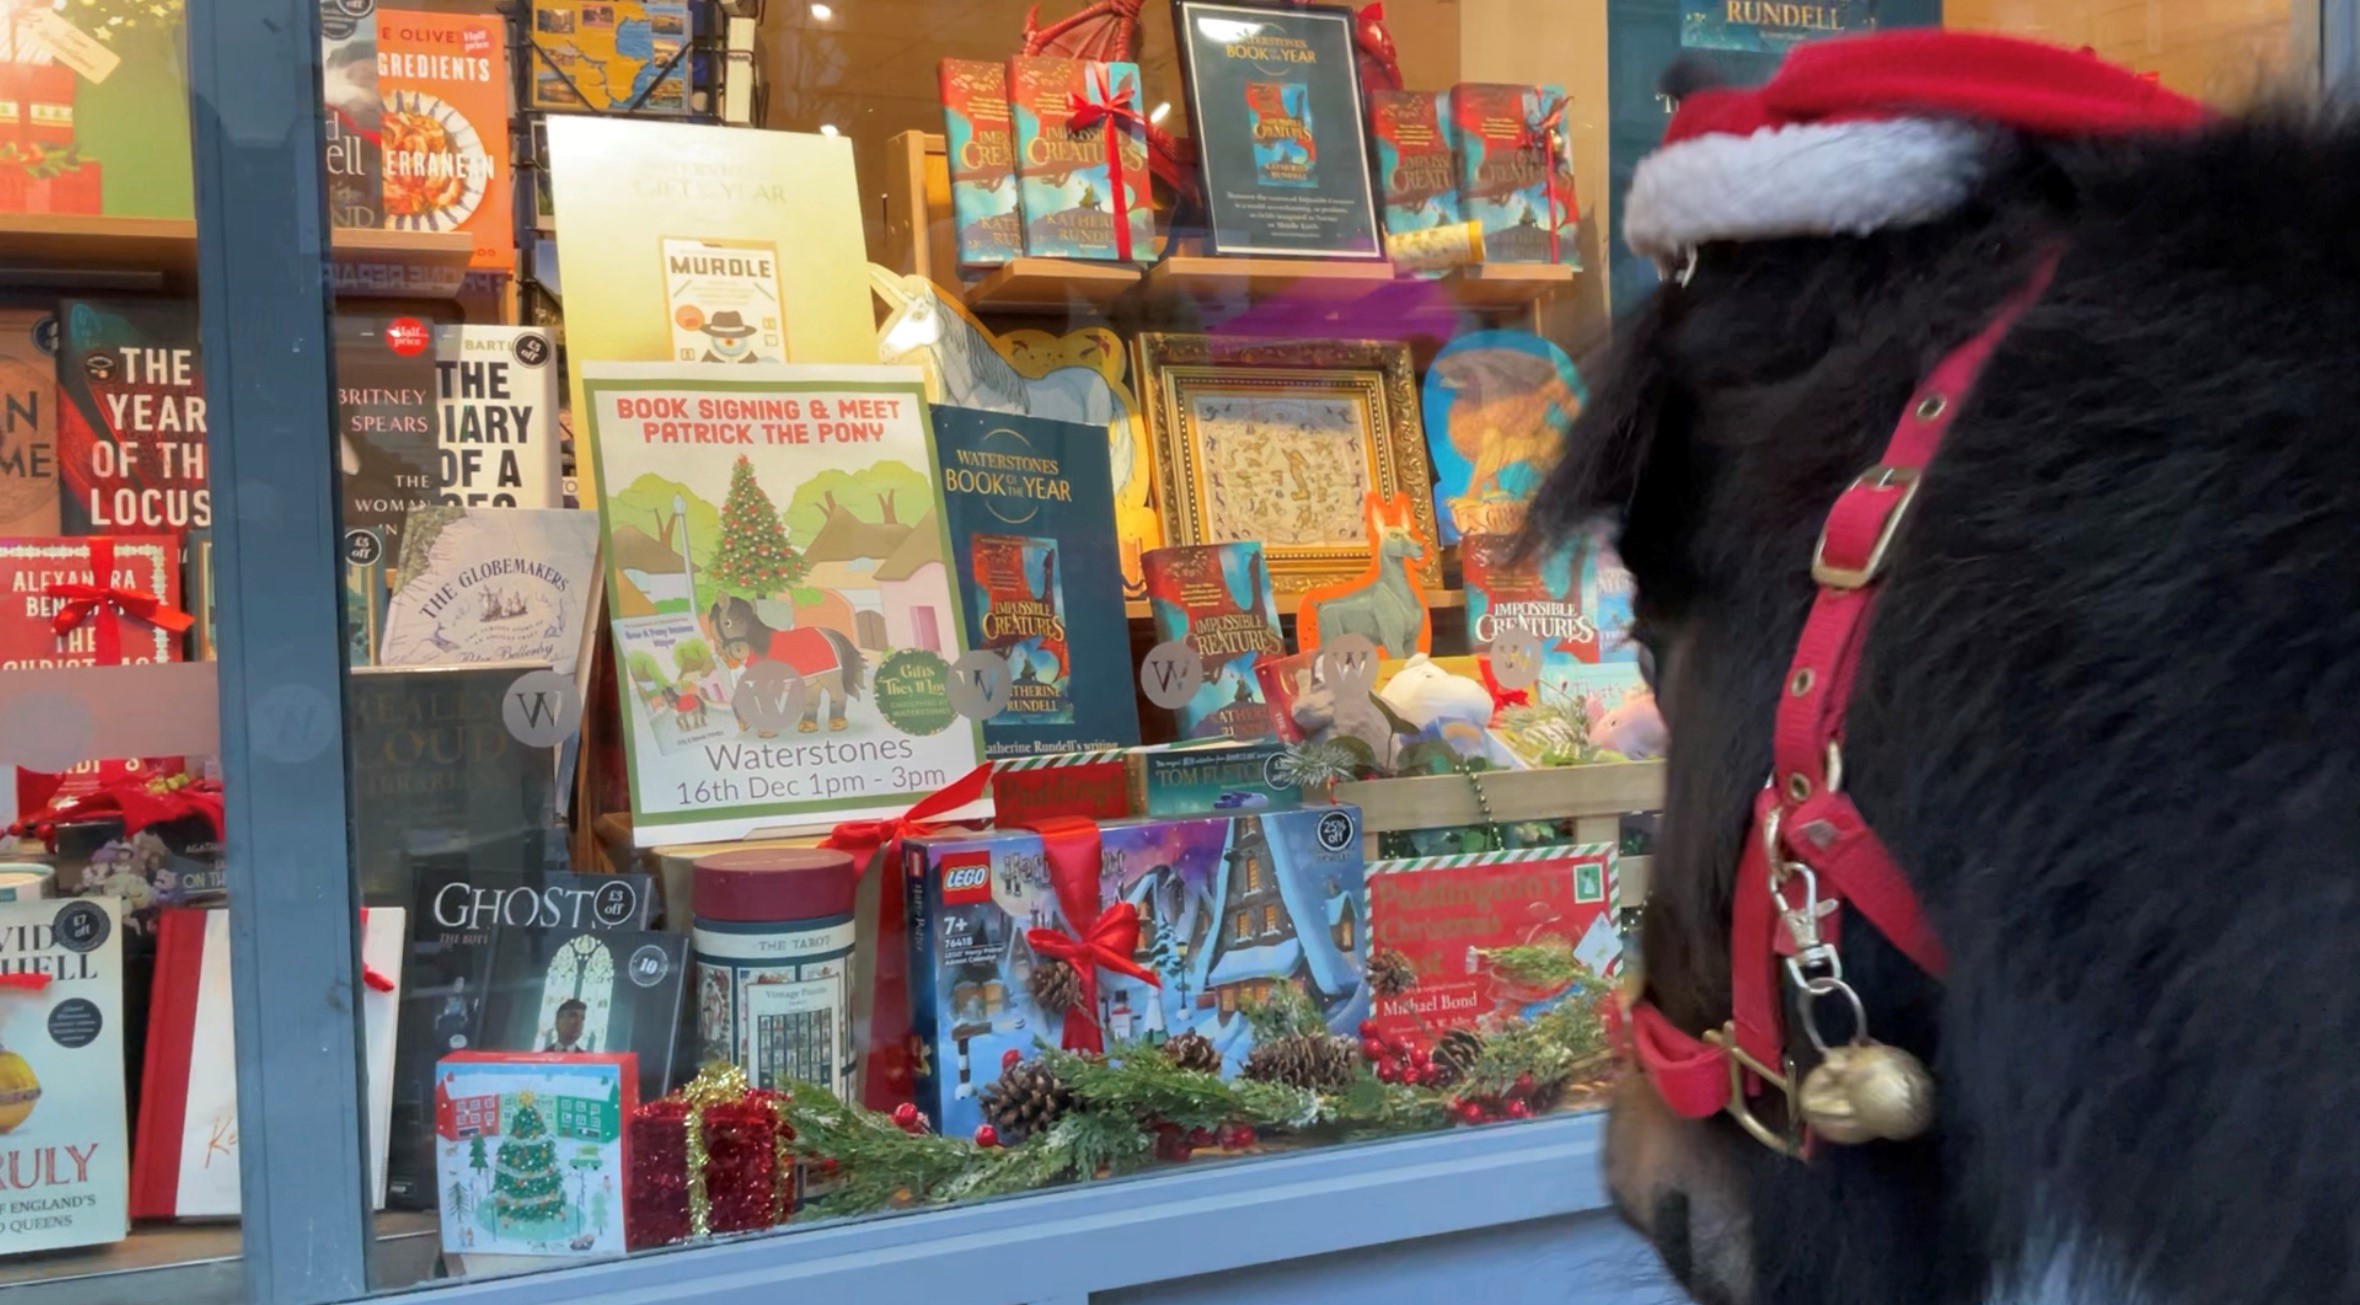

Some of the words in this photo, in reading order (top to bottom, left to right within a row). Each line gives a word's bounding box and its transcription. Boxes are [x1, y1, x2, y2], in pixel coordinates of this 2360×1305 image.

[1726, 0, 1844, 30] RUNDELL
[378, 53, 490, 82] GREDIENTS
[1027, 136, 1143, 171] CREATUES
[670, 255, 772, 278] MURDLE
[119, 347, 192, 386] THE
[436, 361, 511, 400] THE
[339, 389, 427, 406] BRITNEY
[617, 398, 688, 420] BOOK
[699, 399, 801, 421] SIGNING
[810, 399, 830, 420] &
[838, 399, 901, 420] MEET
[106, 393, 208, 433] YEAR
[351, 416, 428, 433] SPEARS
[643, 422, 754, 444] PATRICK
[761, 423, 810, 445] THE
[818, 422, 886, 443] PONY
[92, 440, 138, 478] OF
[497, 450, 522, 488] A
[956, 449, 1060, 476] WATERSTONES
[395, 474, 430, 488] THE
[945, 468, 1007, 497] BOOK
[1022, 476, 1073, 503] YEAR
[90, 488, 212, 528] LOCUS
[12, 569, 137, 593] ALEXANRA
[418, 582, 458, 620] THE
[458, 558, 570, 593] GLOBEMAKERS
[994, 601, 1051, 617] IMPOSSIBLE
[1494, 601, 1578, 617] IMPOSSIBLE
[982, 612, 1065, 642] CREATURES
[1195, 613, 1263, 633] IMPOSSIBLE
[1475, 612, 1595, 644] CREATURES
[900, 664, 936, 679] Gifts
[1151, 660, 1193, 694] W
[1332, 651, 1369, 683] W
[515, 690, 561, 729] W
[745, 677, 797, 718] W
[704, 737, 914, 773] Waterstones
[1033, 739, 1082, 753] Rundell's
[676, 778, 739, 806] 16th
[749, 776, 800, 801] Dec
[809, 772, 865, 799] 1pm
[892, 766, 946, 792] 3pm
[1156, 768, 1198, 787] TOM
[1322, 820, 1347, 834] 25%
[1327, 832, 1344, 845] off
[183, 873, 205, 889] ON
[945, 866, 987, 889] LEGO
[434, 882, 597, 930] GHOST
[604, 903, 624, 916] off
[73, 926, 91, 938] off
[943, 916, 968, 936] 7+
[759, 940, 786, 952] THE
[791, 935, 831, 950] TAROT
[1383, 994, 1437, 1017] Michael
[1441, 989, 1478, 1010] Bond
[10, 1194, 97, 1215] ENGLAND'S
[10, 1215, 73, 1233] QUEENS
